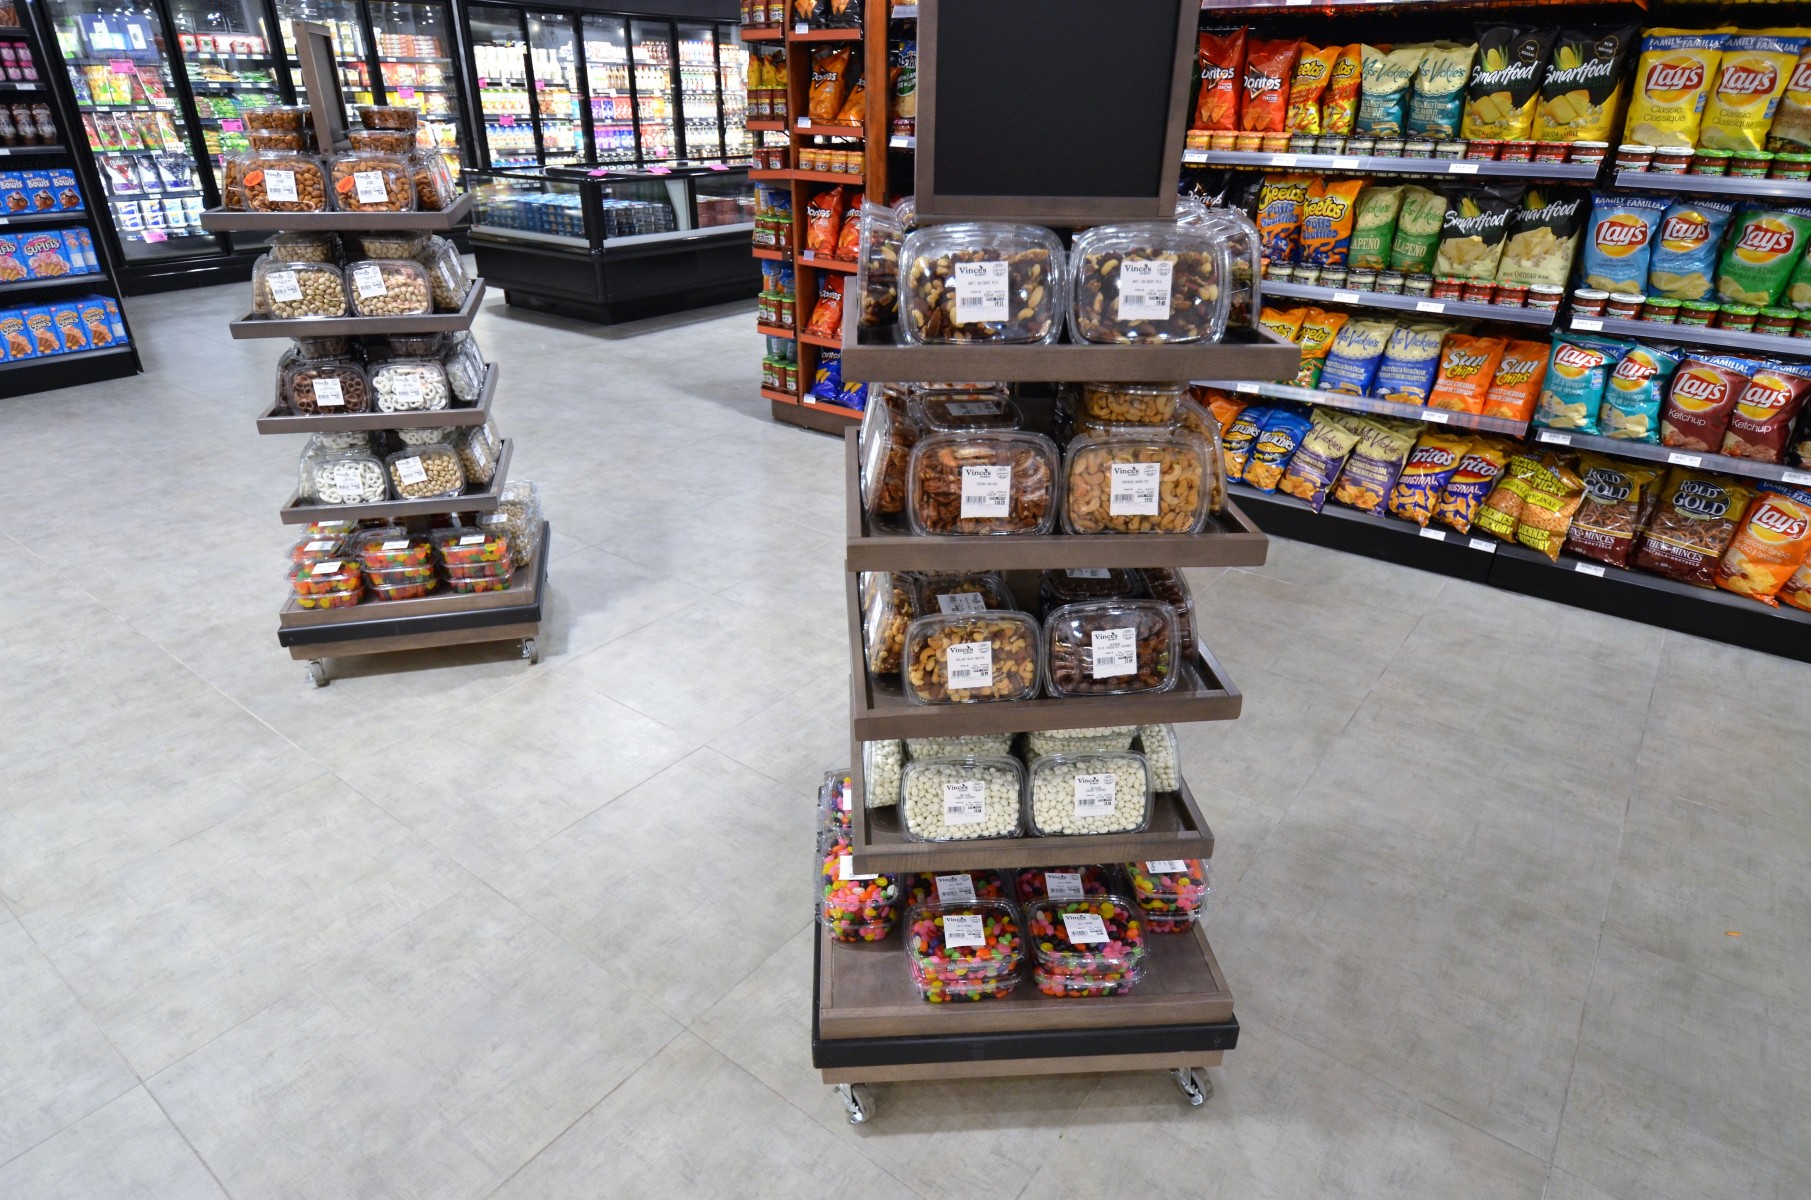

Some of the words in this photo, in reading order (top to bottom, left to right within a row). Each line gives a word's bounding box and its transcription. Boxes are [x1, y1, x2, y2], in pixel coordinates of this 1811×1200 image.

[1297, 61, 1325, 78] eetos
[1471, 60, 1538, 86] Smartfood
[1543, 58, 1614, 86] Smartfood
[1643, 113, 1686, 123] Classique
[1650, 104, 1683, 114] Classic
[1719, 108, 1751, 119] Classic
[1712, 116, 1754, 128] Classique
[1259, 183, 1306, 212] Cheetos
[1303, 196, 1346, 220] heetos
[1305, 217, 1332, 229] Puffs
[1444, 208, 1510, 232] Smartfood
[1597, 222, 1647, 246] Lay's
[1392, 238, 1427, 258] ALAPEÑO
[1442, 350, 1488, 369] Sun
[1495, 358, 1539, 376] Sun
[1446, 364, 1481, 378] Chips
[1496, 371, 1531, 387] Chips
[1674, 373, 1726, 401] Lay's
[1668, 408, 1706, 427] Ketchup
[1732, 418, 1772, 434] Ketchup
[1409, 445, 1456, 466] Fritos
[1588, 467, 1621, 485] ROLD
[1584, 477, 1630, 501] GOLD
[1680, 479, 1719, 499] ROLD
[1673, 491, 1727, 517] GOLD
[1751, 503, 1805, 535] Lay's
[1585, 531, 1615, 546] MINCES
[1672, 546, 1703, 562] MINCES
